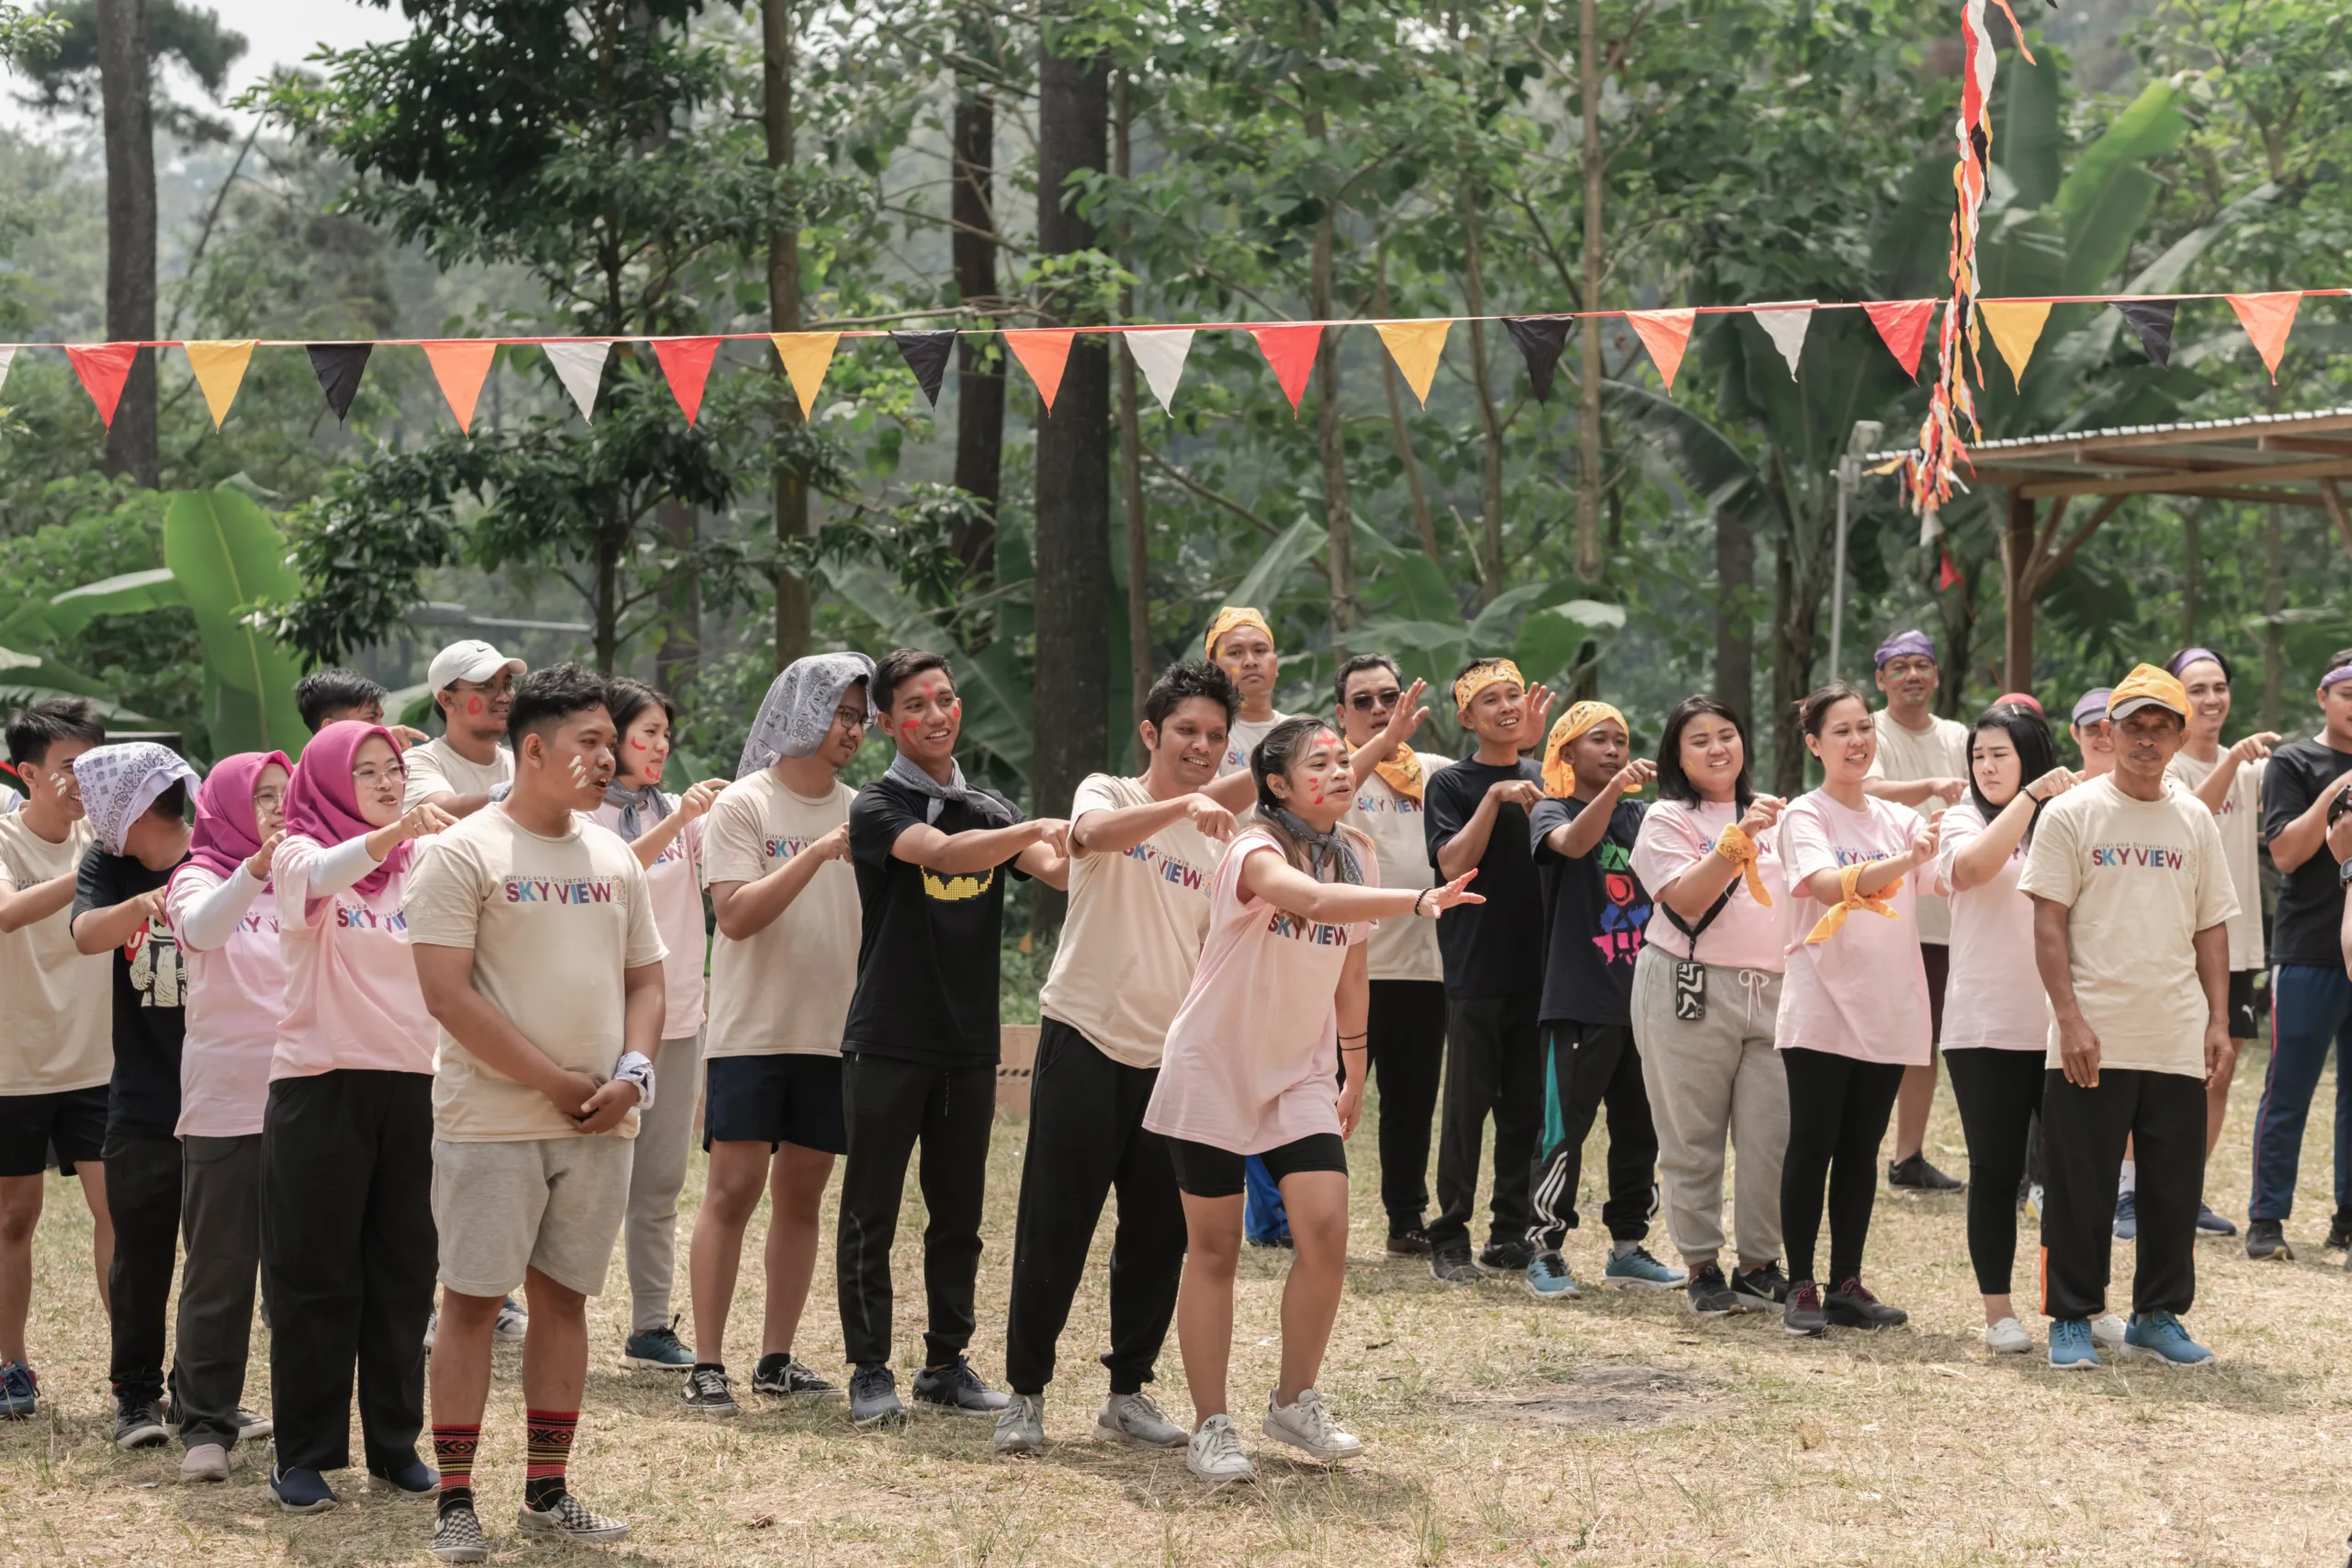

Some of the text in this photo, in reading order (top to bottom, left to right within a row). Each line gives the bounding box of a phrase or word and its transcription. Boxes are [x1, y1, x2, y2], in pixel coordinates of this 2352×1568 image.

[1227, 750, 1246, 766] SK
[1358, 796, 1385, 812] SKY
[1389, 797, 1423, 814] VIEW
[765, 840, 801, 857] SKY
[1836, 851, 1858, 866] KY
[2092, 847, 2132, 867] SKY
[2134, 849, 2183, 871] VIEW
[1157, 855, 1203, 890] VIEW
[505, 881, 550, 903] SKY
[554, 882, 611, 905] VIEW
[337, 907, 378, 929] SKY
[1268, 912, 1349, 946] SKY VIEW
